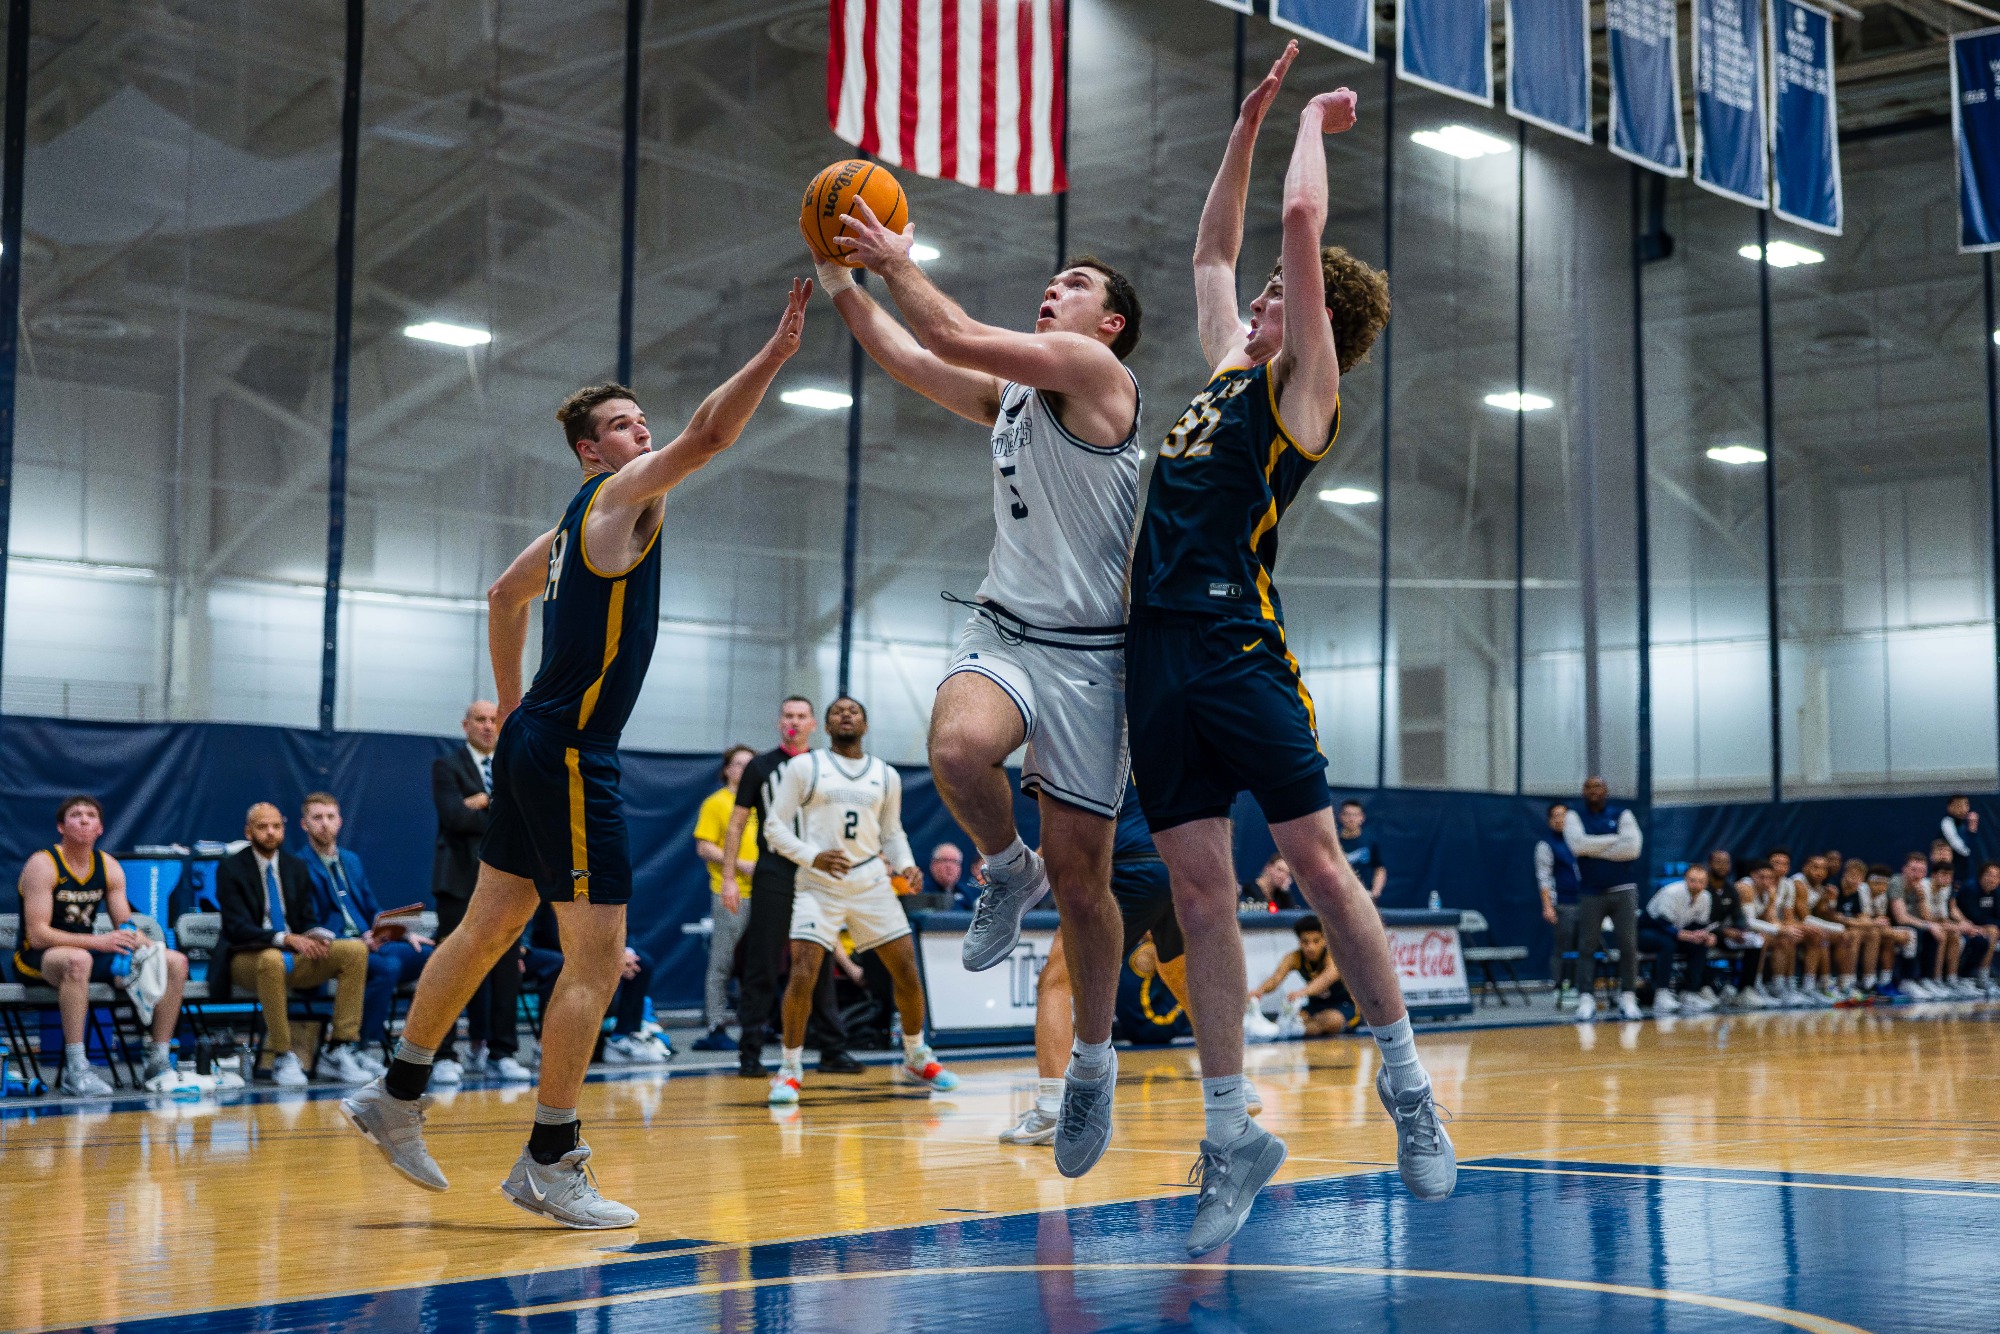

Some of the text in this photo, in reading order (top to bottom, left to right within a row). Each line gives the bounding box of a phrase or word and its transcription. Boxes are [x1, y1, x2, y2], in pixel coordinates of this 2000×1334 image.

[1160, 408, 1222, 459] 32
[999, 464, 1029, 520] 5
[845, 811, 859, 839] 2
[1388, 931, 1455, 977] oca-Cola
